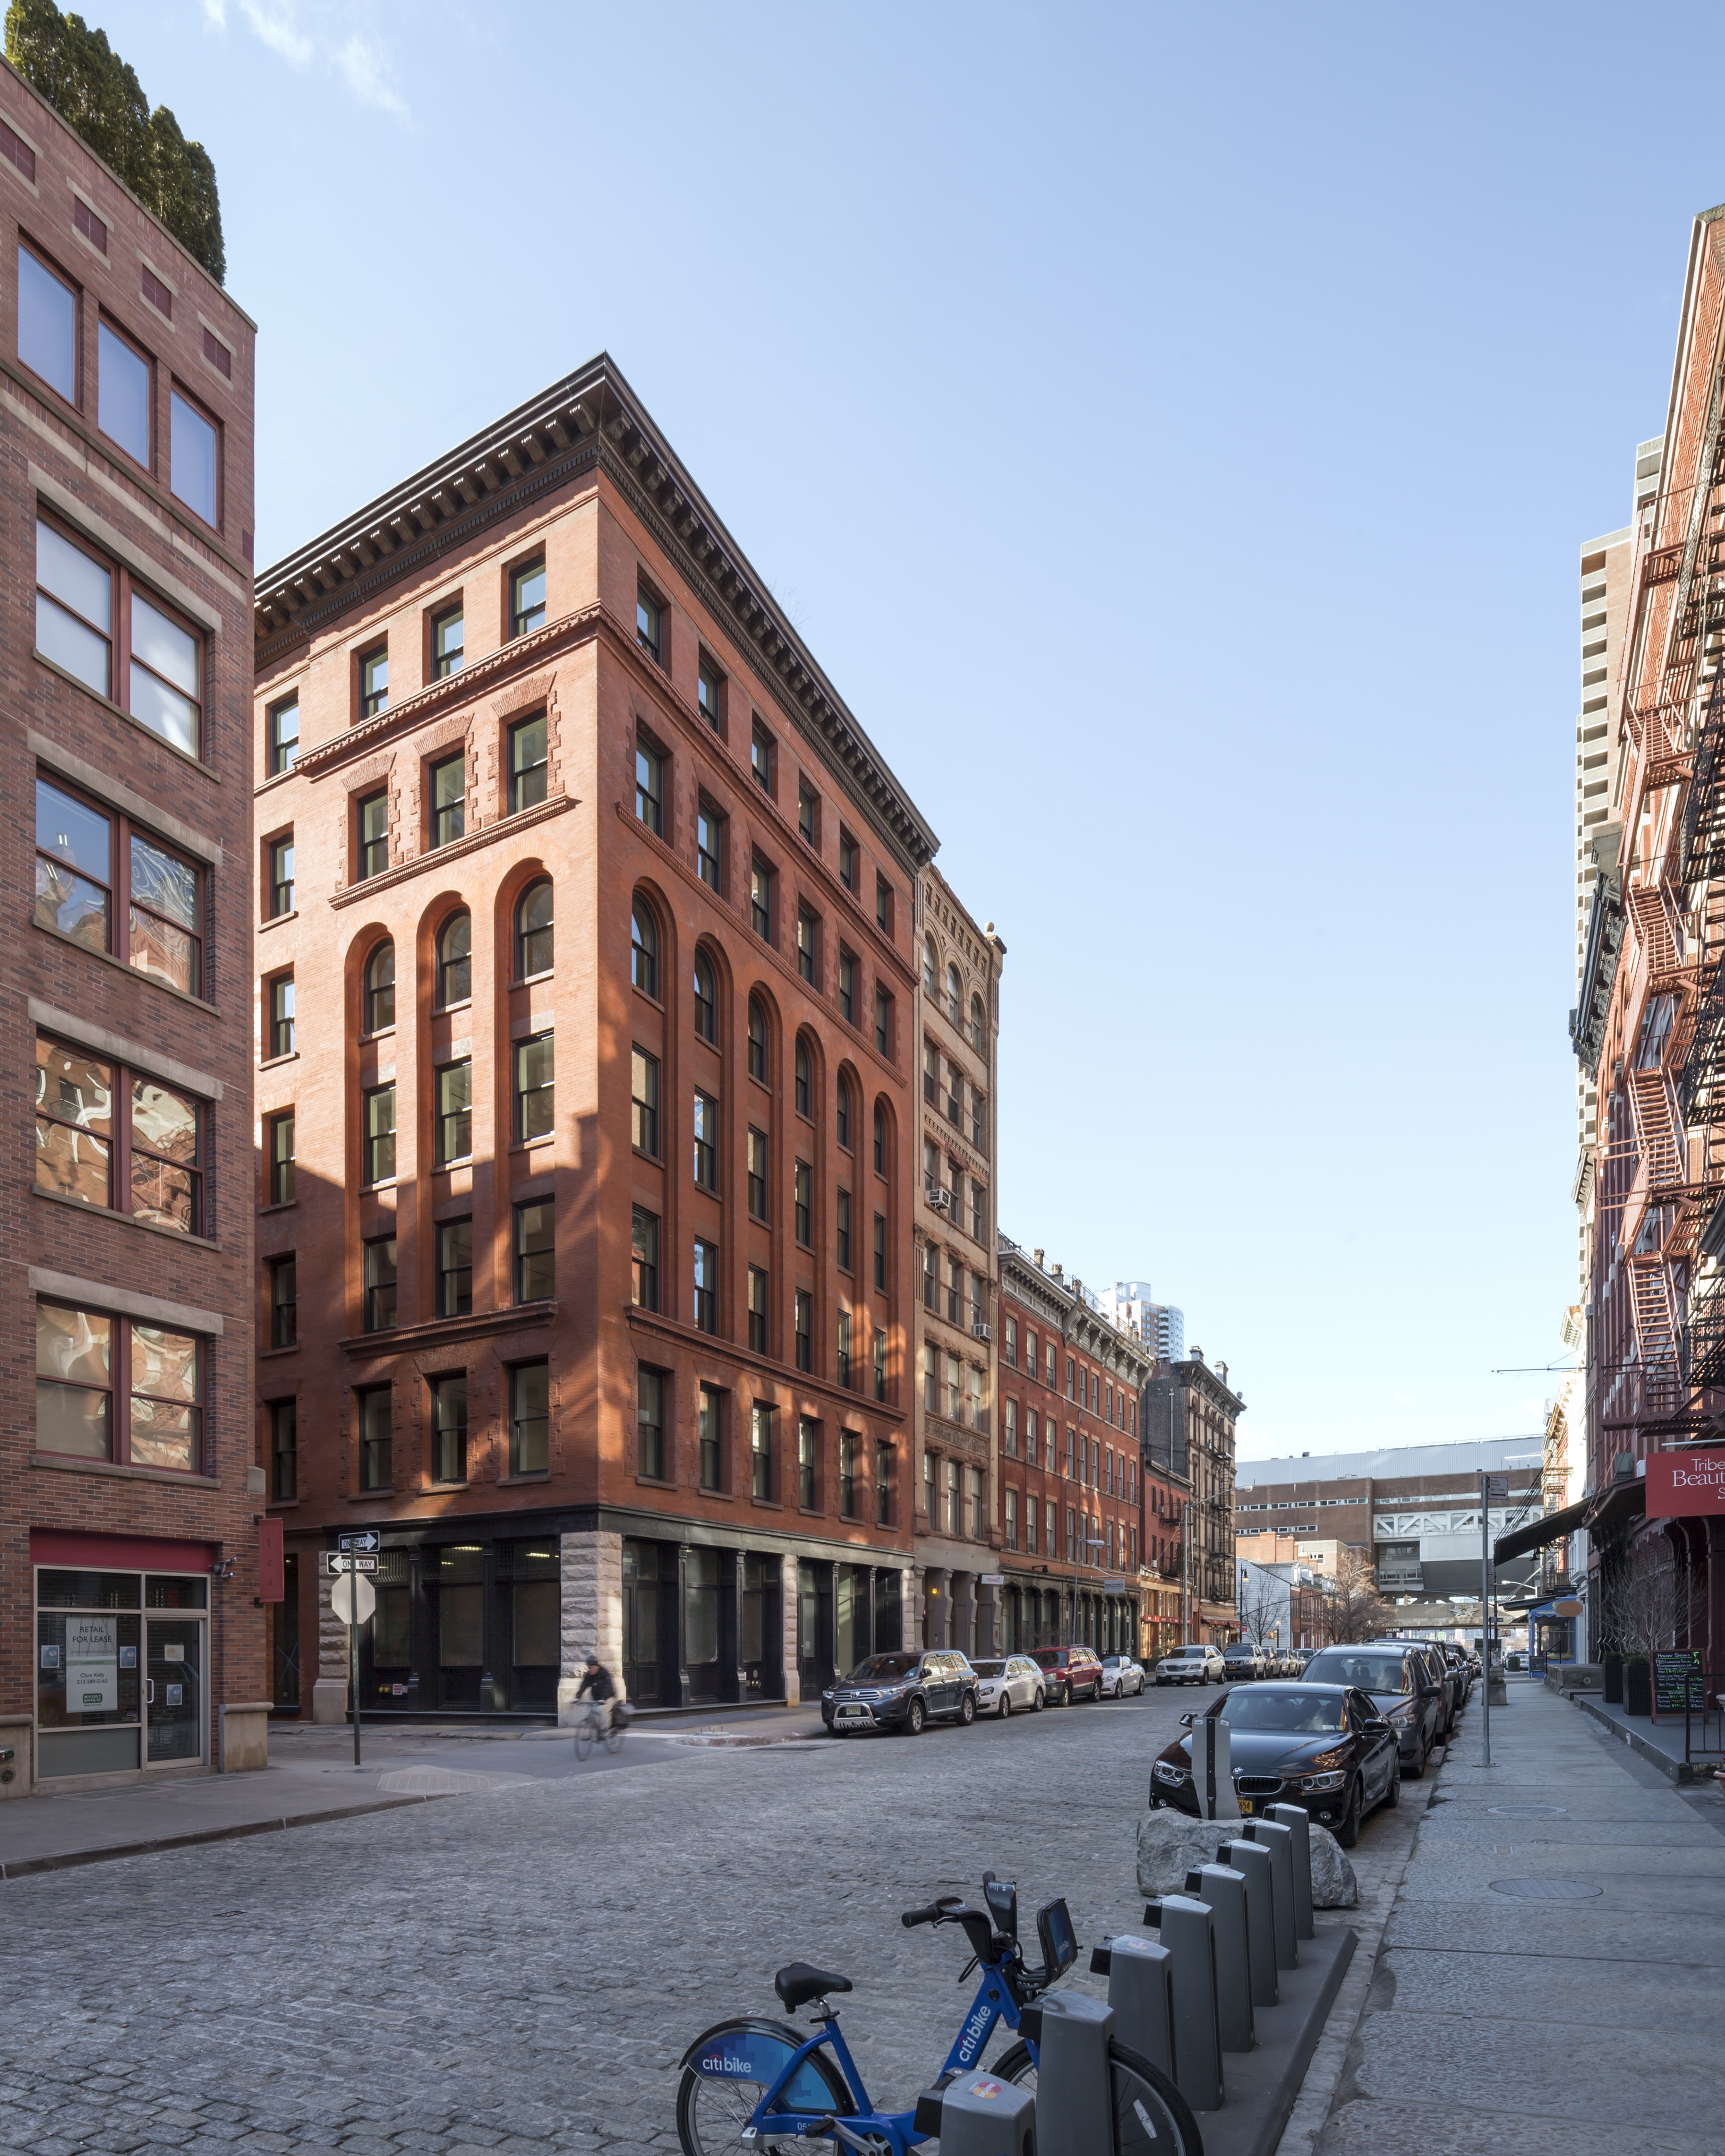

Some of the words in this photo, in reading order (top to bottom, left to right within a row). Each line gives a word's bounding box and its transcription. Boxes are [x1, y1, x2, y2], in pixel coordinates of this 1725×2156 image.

[1672, 1470, 1725, 1487] Beaut
[356, 1538, 367, 1546] WAY
[1238, 1801, 1250, 1810] 654
[966, 2006, 991, 2039] bike
[724, 2057, 751, 2073] bike
